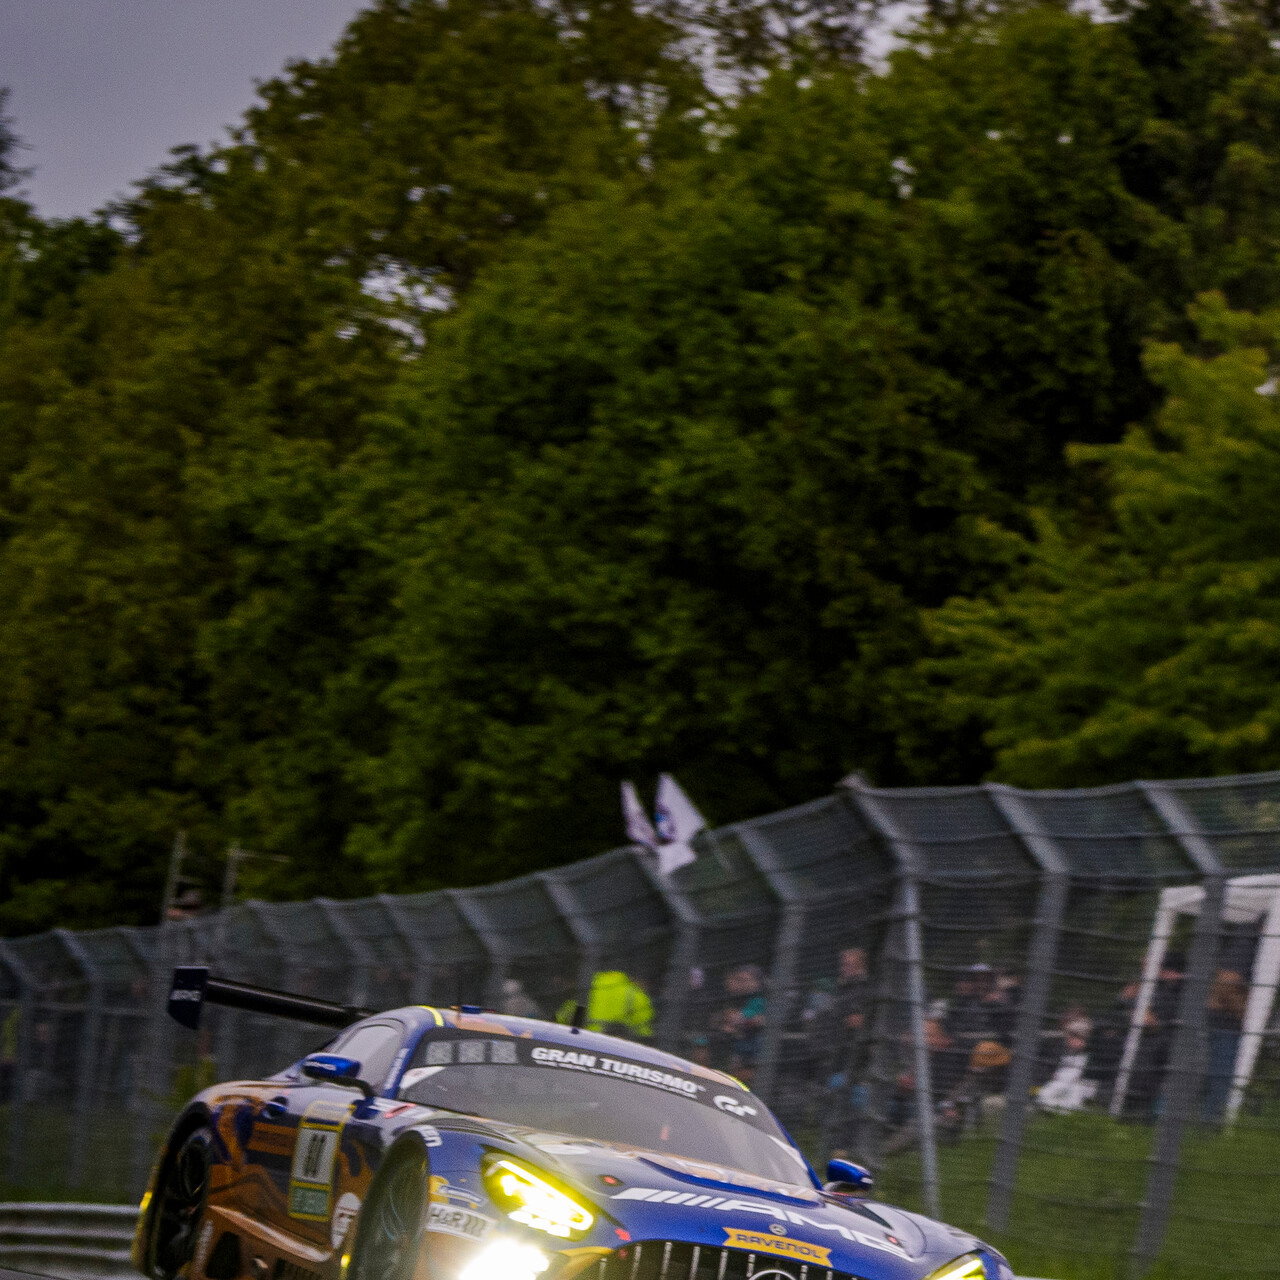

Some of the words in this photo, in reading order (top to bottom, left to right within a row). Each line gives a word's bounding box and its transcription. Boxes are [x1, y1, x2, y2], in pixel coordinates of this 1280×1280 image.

[531, 1047, 597, 1069] GRAN
[724, 1199, 914, 1263] AMG
[736, 1232, 822, 1260] RAVENOL
